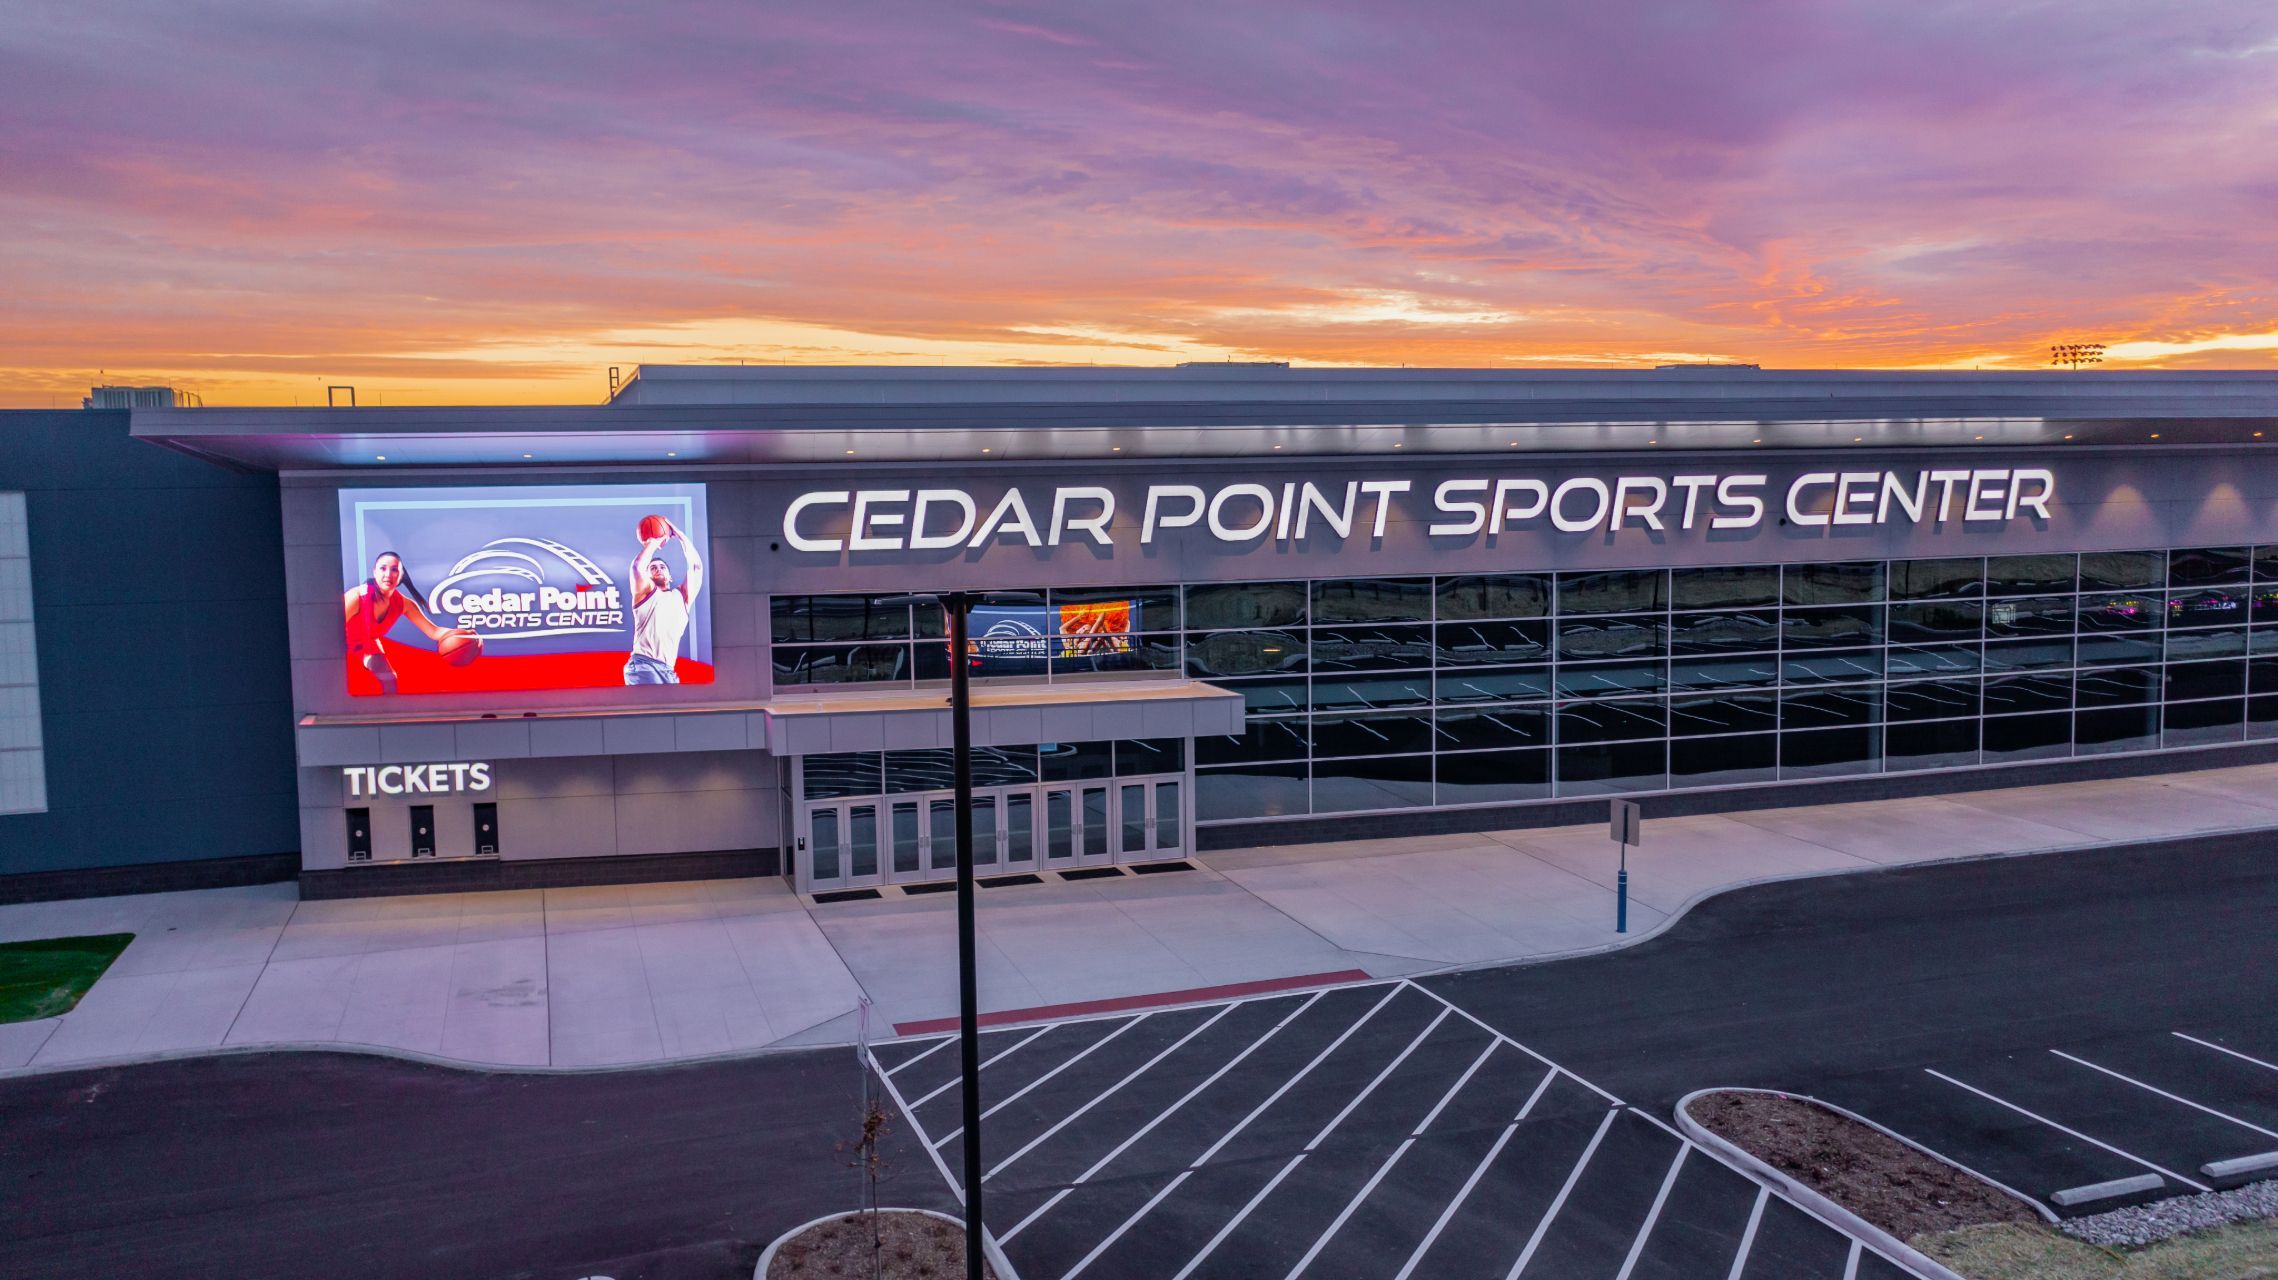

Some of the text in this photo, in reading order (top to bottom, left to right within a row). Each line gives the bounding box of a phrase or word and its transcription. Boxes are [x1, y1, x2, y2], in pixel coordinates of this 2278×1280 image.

[783, 469, 2054, 552] CEDAR POINT SPORTS CENTER
[441, 585, 621, 614] Cedar Point
[457, 610, 624, 629] SPORTS CENTER
[343, 762, 491, 795] TICKETS
